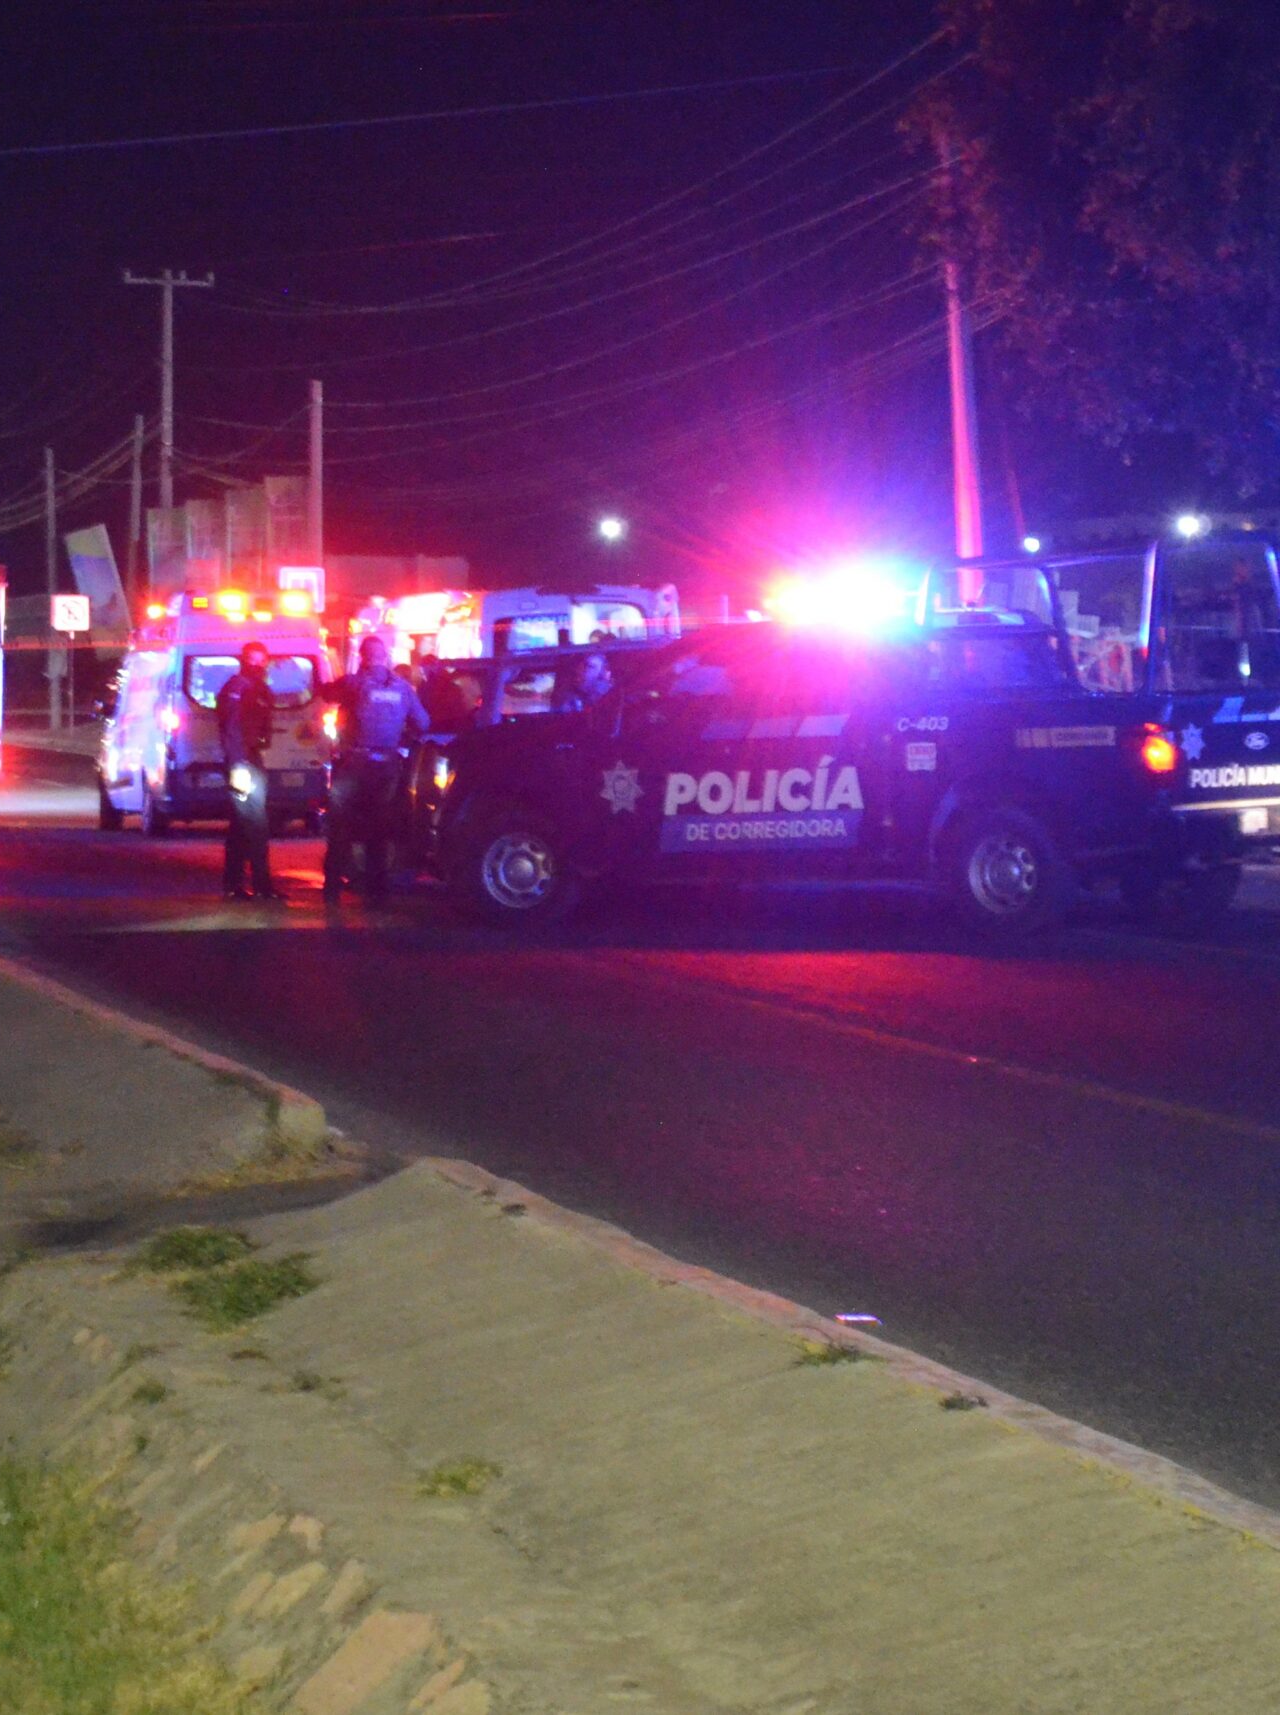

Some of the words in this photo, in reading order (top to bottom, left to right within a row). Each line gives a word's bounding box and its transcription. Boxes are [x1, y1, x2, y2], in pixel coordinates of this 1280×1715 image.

[664, 755, 864, 815] POLICÍA
[1191, 765, 1246, 787] POLICÍA
[686, 824, 709, 841] DE
[715, 819, 847, 840] CORREGIDORA
